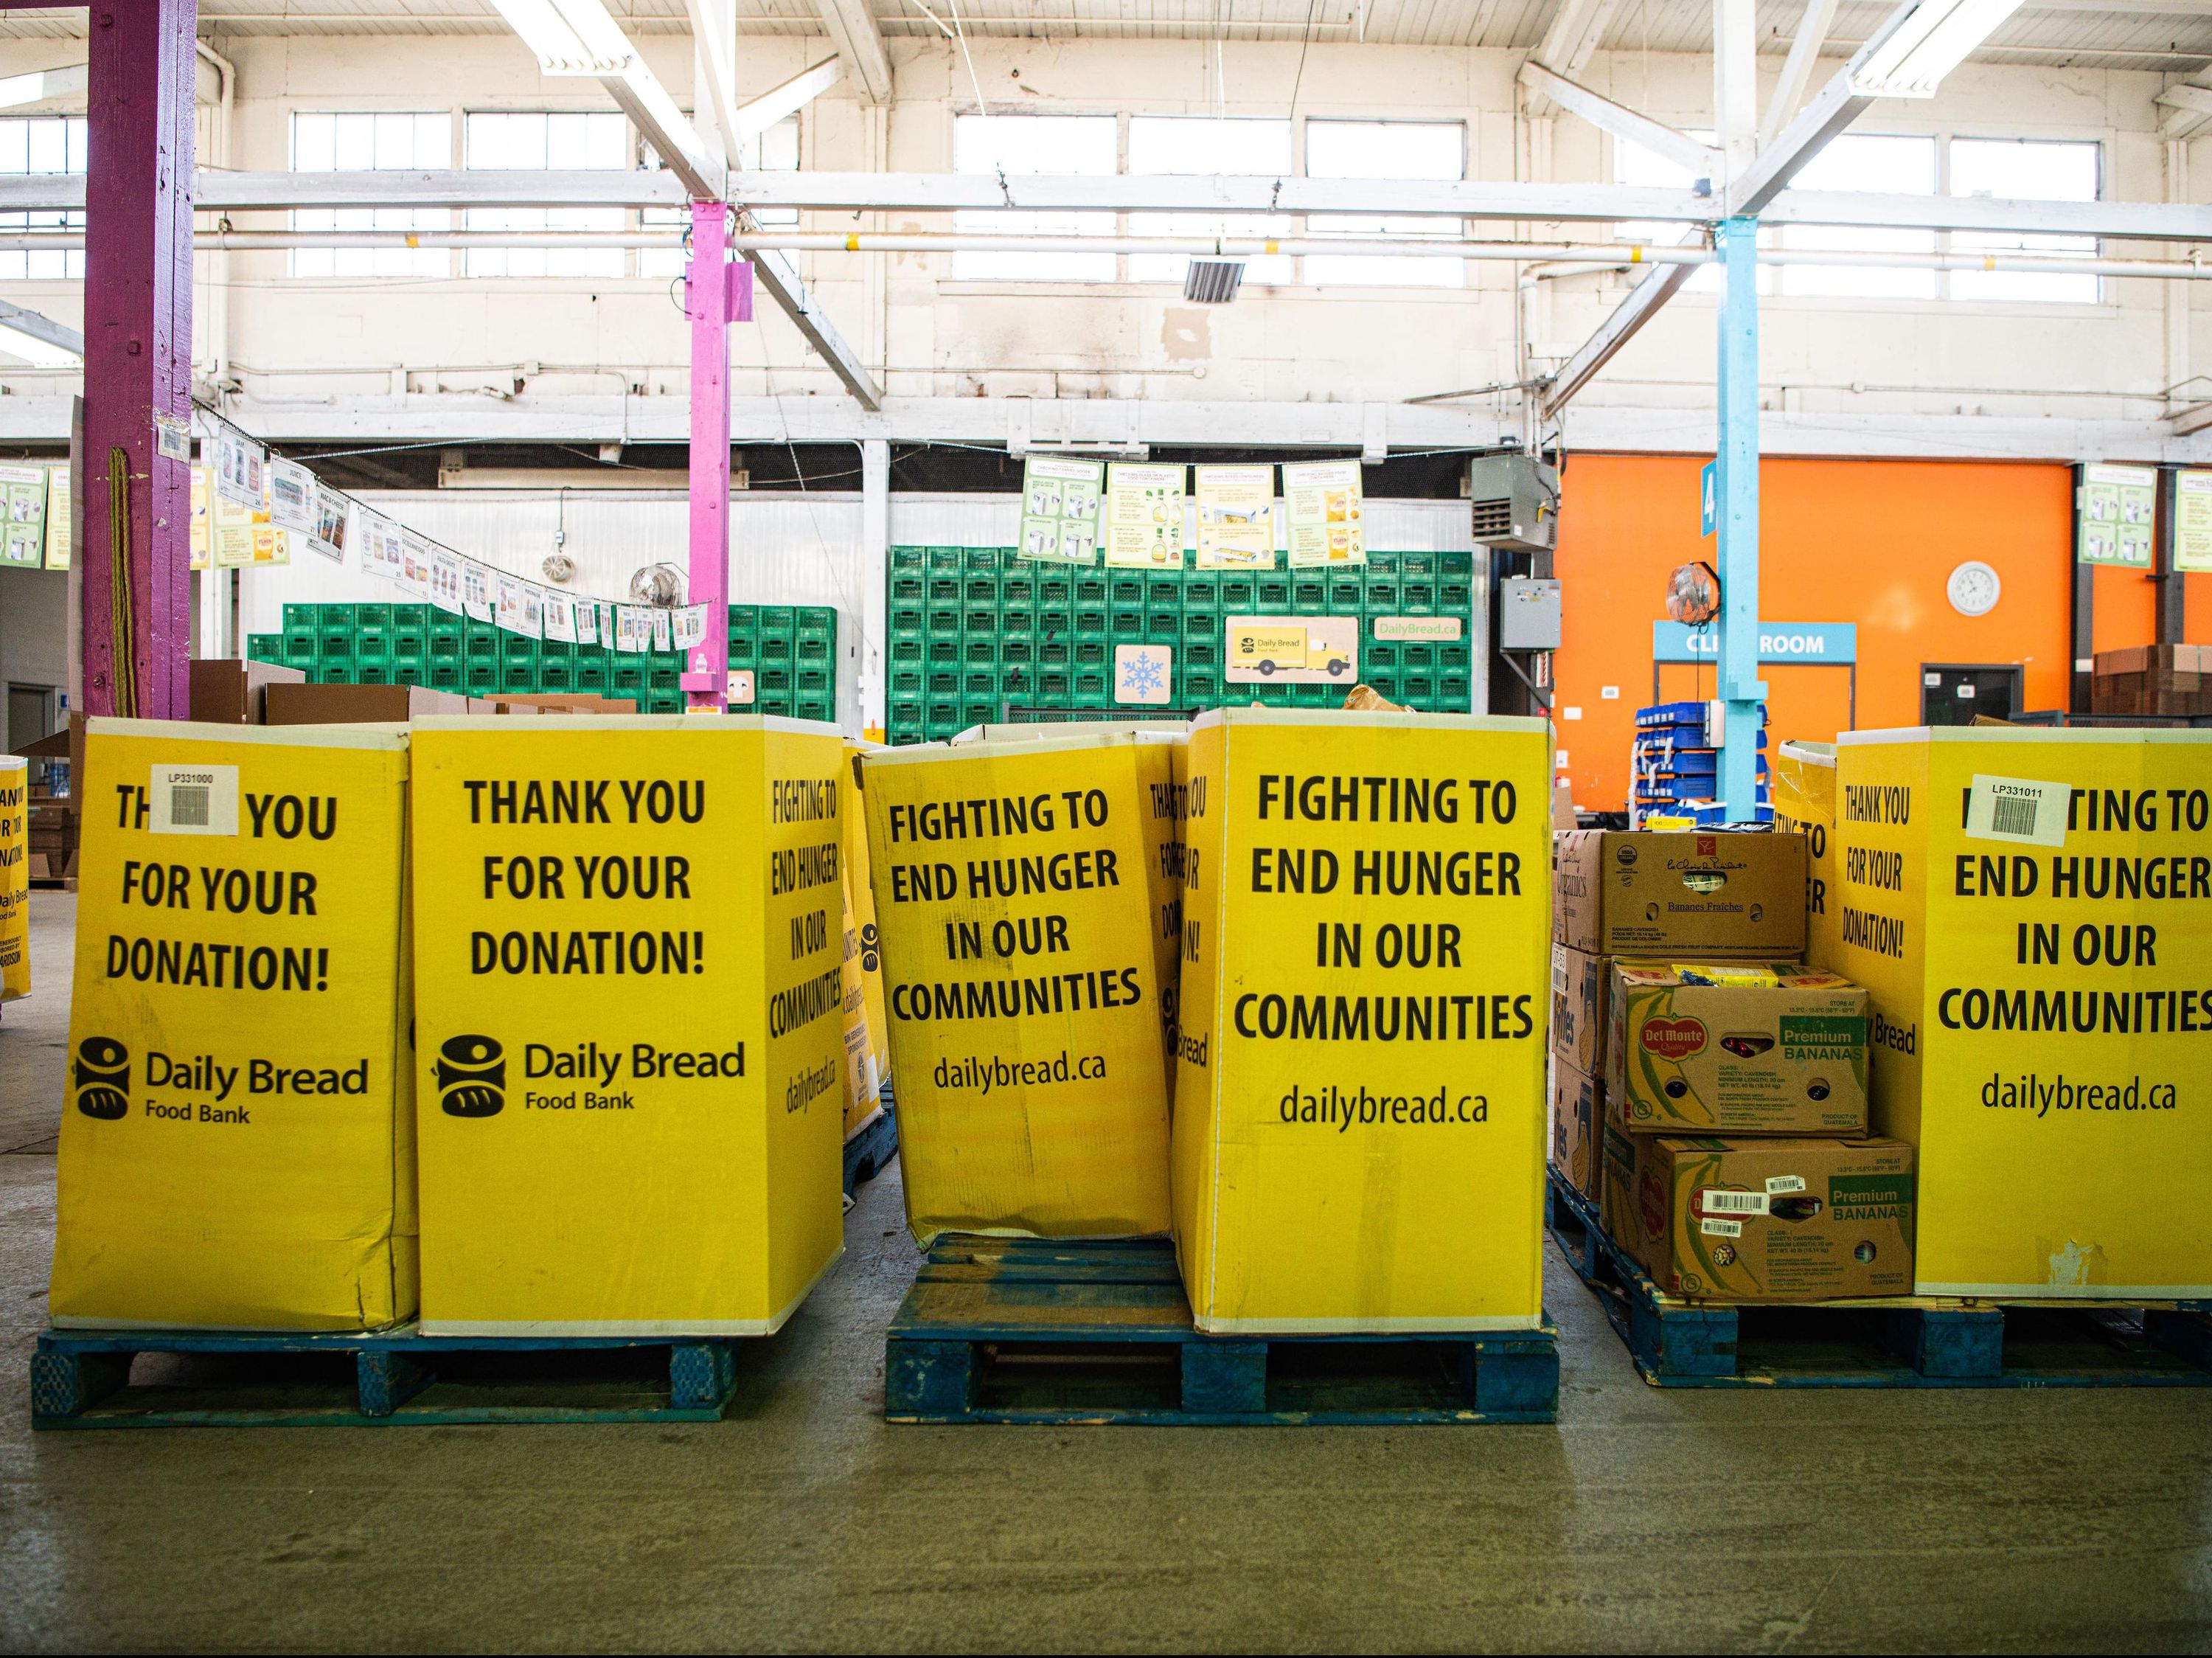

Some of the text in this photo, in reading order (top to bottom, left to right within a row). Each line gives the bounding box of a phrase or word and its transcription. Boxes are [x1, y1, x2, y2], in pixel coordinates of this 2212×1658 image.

[236, 439, 245, 448] JAM
[289, 469, 302, 479] JUICE
[1704, 472, 1714, 523] 4
[1257, 639, 1299, 648] Daily Bread
[1380, 623, 1457, 636] DailyBread.ca
[1759, 635, 1824, 653] ROOM
[168, 773, 214, 784] LP331000
[1187, 775, 1207, 818] OU
[1259, 775, 1516, 825] FIGHTING TO
[1992, 785, 2043, 798] LP331011
[246, 793, 337, 841] YOU
[463, 780, 705, 824] THANK YOU
[773, 780, 836, 824] FIGHTING TO
[890, 788, 1108, 842] FIGHTING TO
[1150, 783, 1172, 819] THA
[1845, 784, 1882, 825] THANK
[1883, 785, 1910, 825] YOU
[1962, 788, 2208, 832] TING TO
[122, 861, 318, 916] FOR YOUR
[484, 856, 691, 899] FOR YOUR
[772, 842, 838, 896] END HUNGER
[891, 849, 1119, 903] END HUNGER
[1252, 848, 1339, 894] END
[1354, 850, 1521, 896] HUNGER
[1847, 846, 1902, 892] FOR YOUR
[1955, 855, 2212, 900] END HUNGER
[1668, 902, 1744, 911] Bananes Fraîches
[471, 931, 705, 975] DONATION!
[791, 909, 827, 961] IN OUR
[946, 915, 1070, 960] IN OUR
[1317, 922, 1461, 968] IN OUR
[1843, 906, 1903, 959] DONATION!
[2017, 923, 2156, 967] IN OUR
[107, 934, 329, 992] DONATION!
[770, 966, 841, 1039] COMMUNITIES
[892, 968, 1141, 1021] COMMUNITIES
[1938, 988, 2212, 1034] COMMUNITIES
[1234, 993, 1533, 1041] COMMUNITIES
[1645, 1029, 1703, 1042] Del Monte
[1784, 1029, 1851, 1043] Premium
[1874, 1013, 1916, 1056] Bread
[525, 1041, 745, 1088] Daily Bread
[1660, 1042, 1686, 1052] Quality
[1784, 1047, 1863, 1061] BANANAS
[146, 1052, 369, 1102] Daily Bread
[787, 1055, 836, 1114] dailybread.ca
[934, 1050, 1106, 1095] dailybread.ca
[146, 1100, 251, 1124] Food Bank
[526, 1092, 635, 1110] Food Bank
[1280, 1085, 1488, 1134] dailybread.ca
[1981, 1072, 2176, 1119] dailybread.ca
[1833, 1206, 1908, 1221] BANANAS
[1834, 1190, 1898, 1203] Premium
